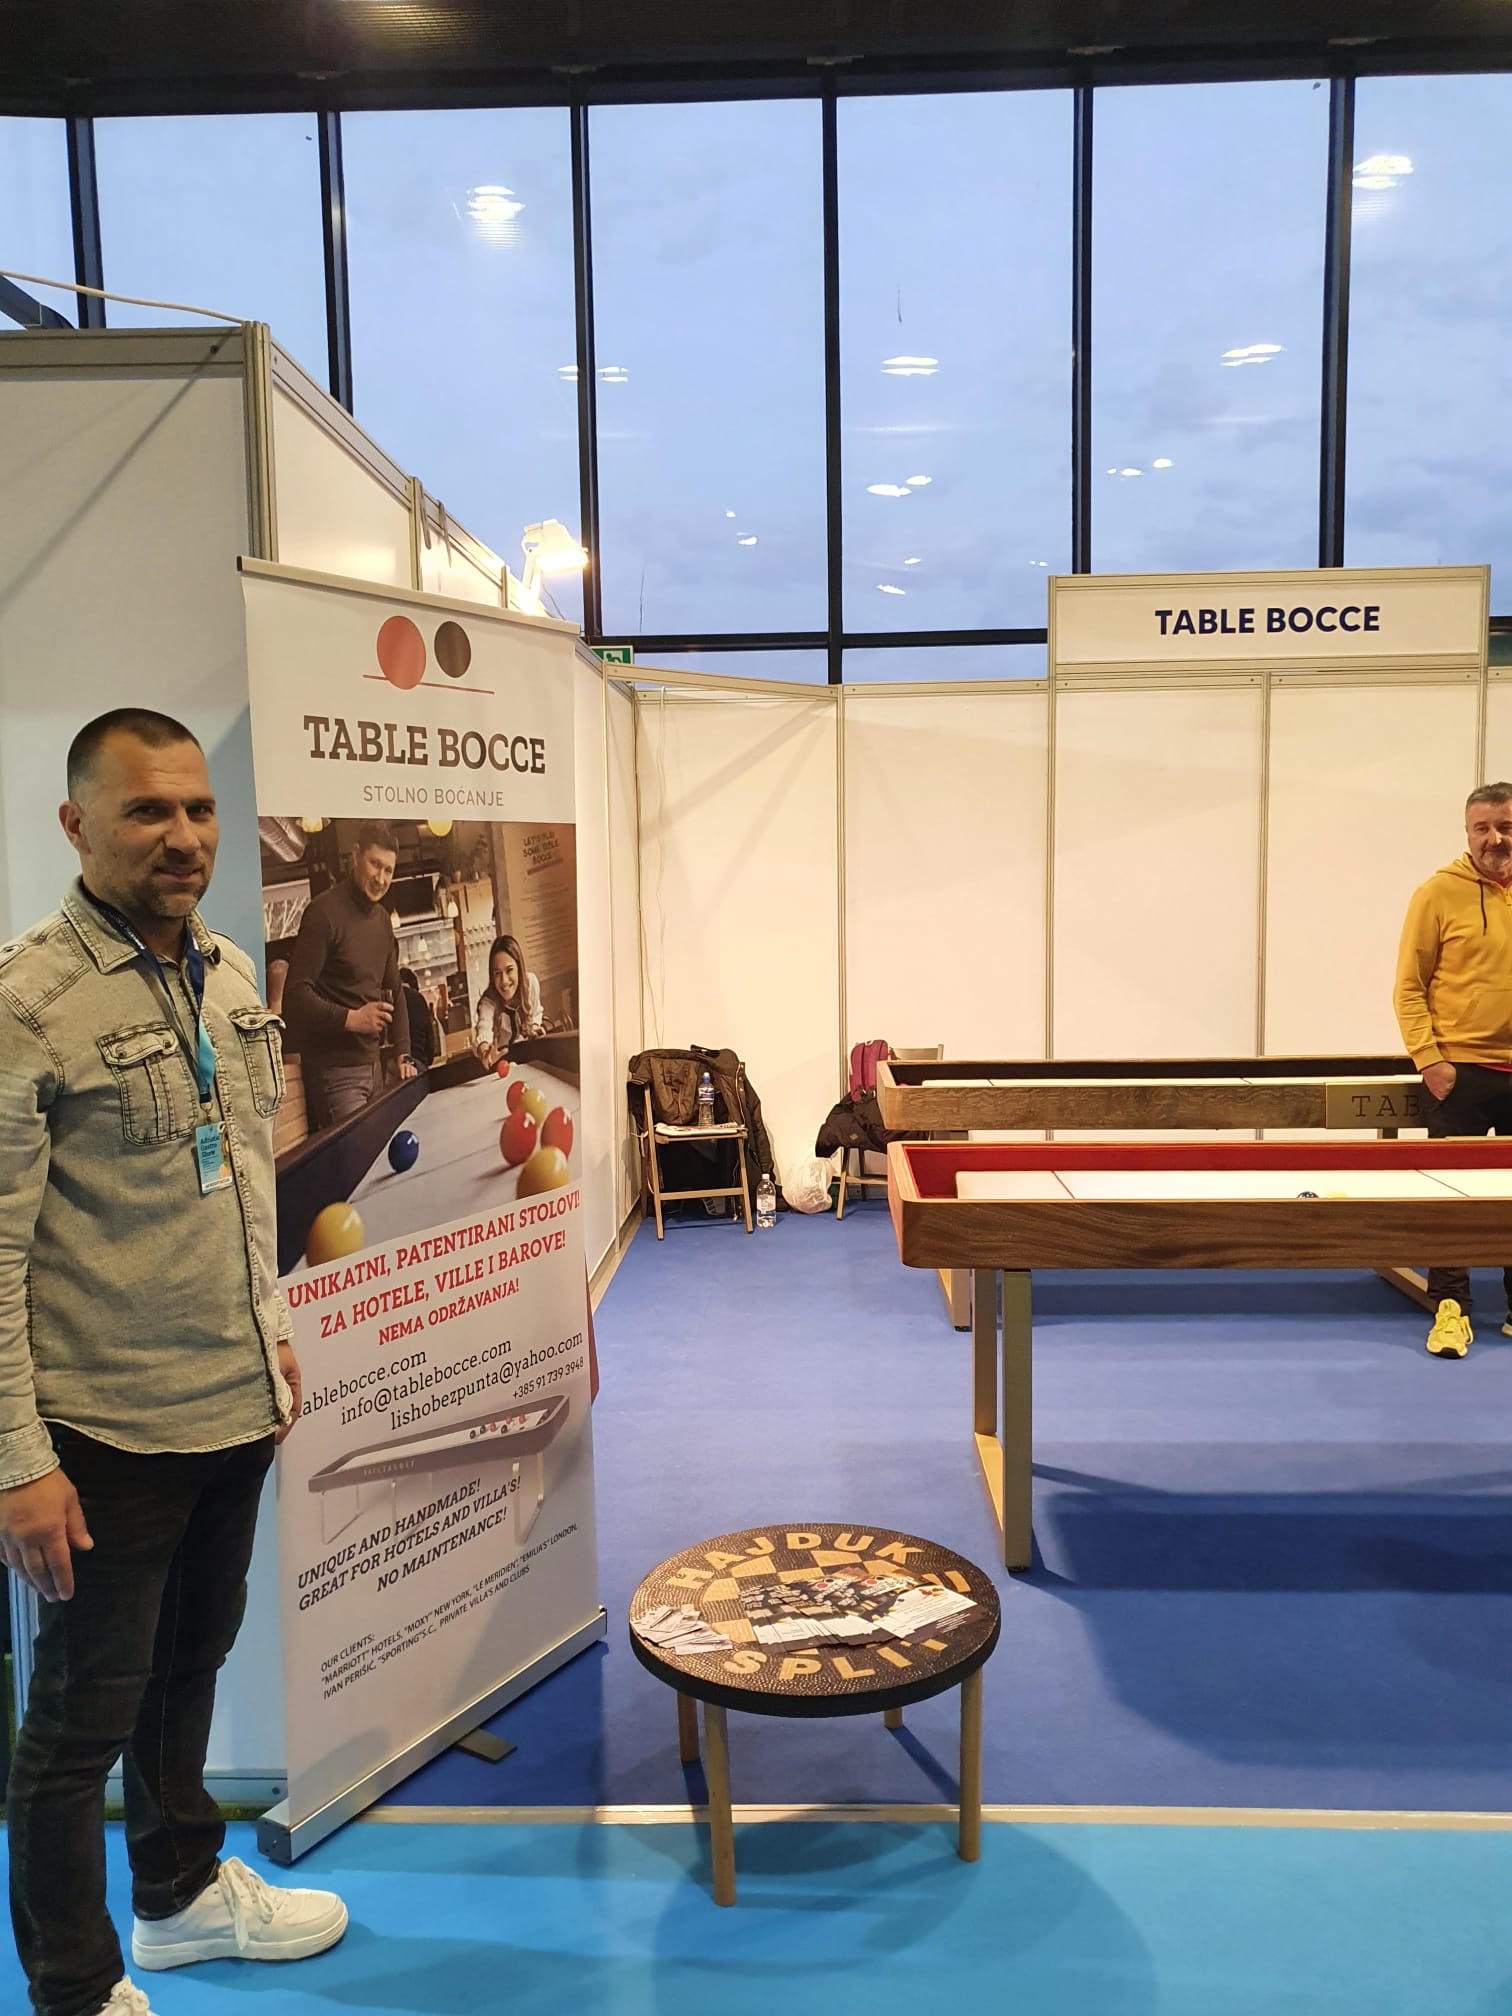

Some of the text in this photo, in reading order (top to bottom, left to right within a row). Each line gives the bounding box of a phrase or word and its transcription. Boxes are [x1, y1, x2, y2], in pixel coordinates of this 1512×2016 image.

[1155, 606, 1380, 636] TABLE BOCCE
[303, 715, 546, 774] TABLE BOCCE
[363, 785, 428, 803] STOLNO
[288, 1189, 580, 1308] UNIKATNI, PATENTIRANI STOLOVI!
[320, 1230, 566, 1338] ZA HOTELE, VILLE I BAROVE!
[379, 1278, 519, 1345] NEMA ODRŽAVANJA!
[298, 1351, 427, 1418] ablebocce.com
[341, 1340, 512, 1425] info@tablebocce.com
[391, 1332, 583, 1430] lishobezpunta@yahoo.com
[512, 1356, 584, 1399] +385 91 739 3948
[298, 1478, 481, 1589] UNIQUE AND HANDMADE!
[299, 1476, 521, 1611] GREAT FOR HOTELS AND VILLA'S!
[377, 1506, 507, 1592] NO MAINTENANCE!
[665, 1532, 924, 1590] HAJDUK
[323, 1681, 343, 1700] IVAN
[440, 1603, 467, 1628] PRIVATE
[494, 1578, 509, 1593] AND
[434, 1600, 451, 1617] NEW
[321, 1633, 375, 1673] OUR CLIENTS:
